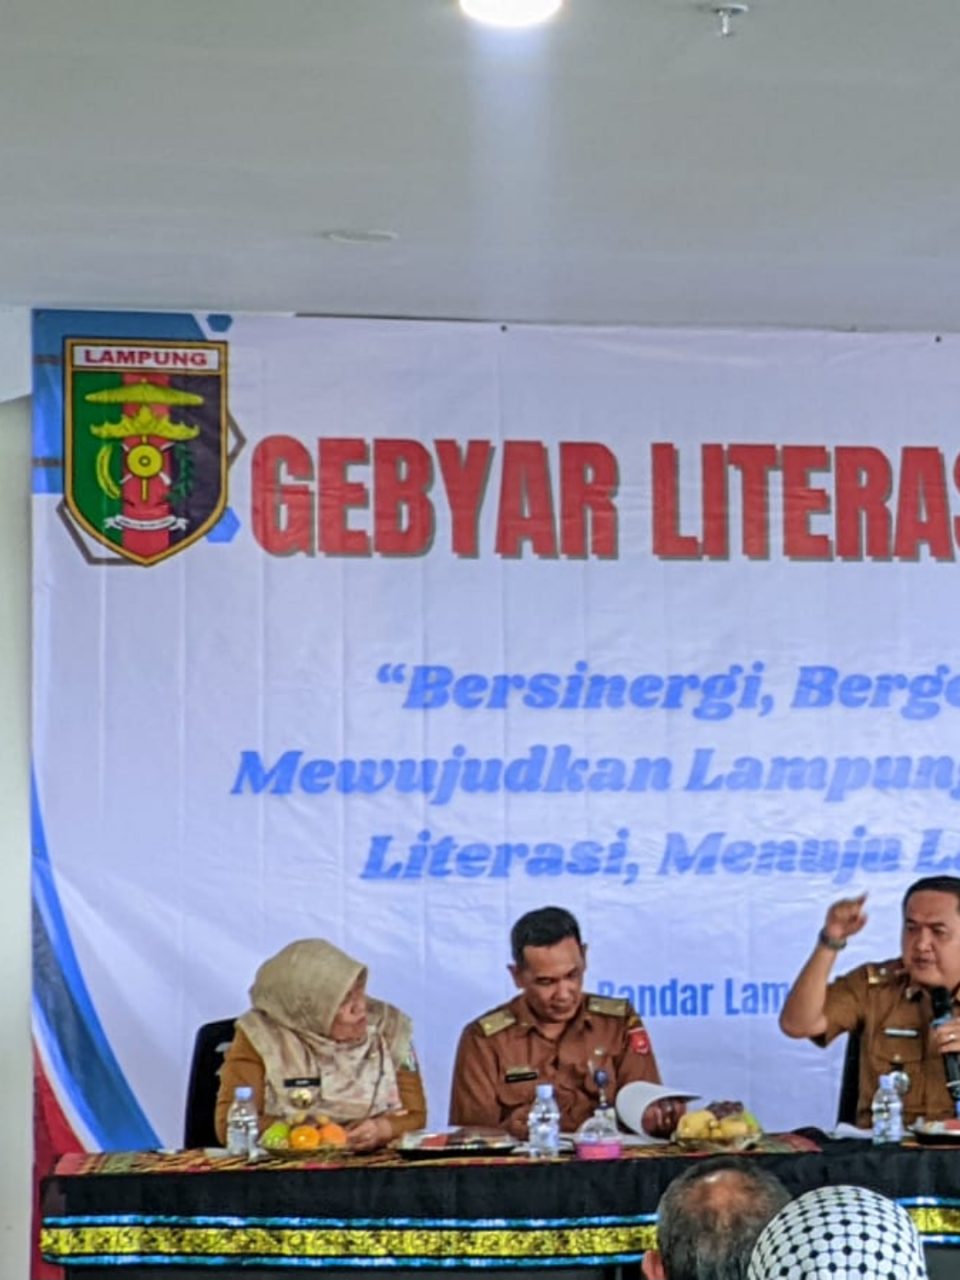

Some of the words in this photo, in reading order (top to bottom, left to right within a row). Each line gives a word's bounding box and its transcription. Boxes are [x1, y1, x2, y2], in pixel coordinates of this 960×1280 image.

[84, 350, 207, 366] LAMPUNG
[251, 435, 619, 560] GEBYAR
[231, 744, 672, 805] Mewujudkan
[360, 828, 639, 885] Literasi,
[656, 825, 900, 885] Menuju
